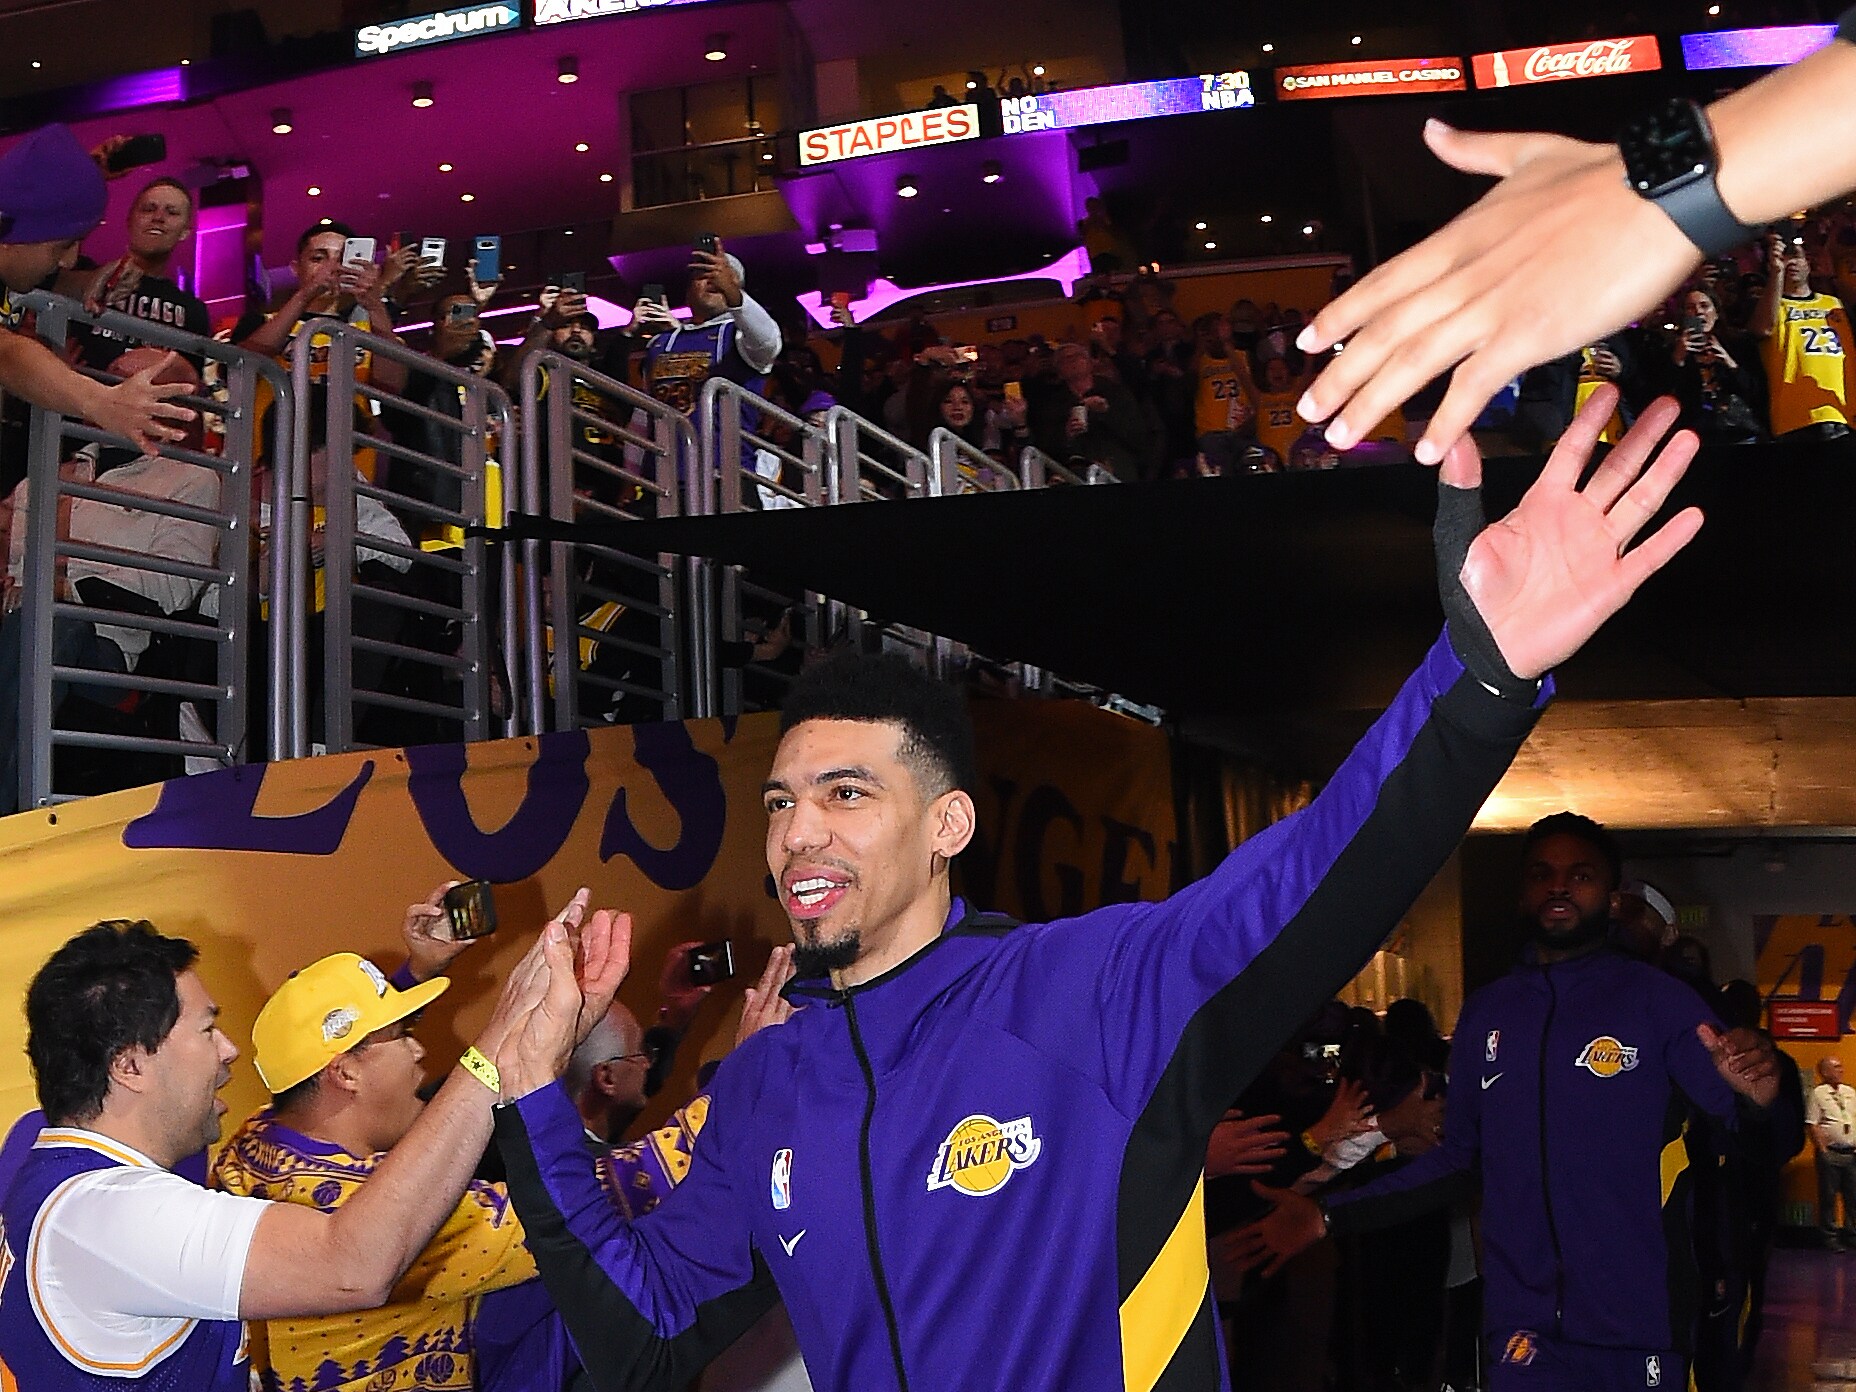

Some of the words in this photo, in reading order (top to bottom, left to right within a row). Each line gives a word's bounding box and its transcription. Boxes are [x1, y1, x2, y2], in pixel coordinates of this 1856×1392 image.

[357, 5, 510, 53] Spectrum
[1524, 40, 1635, 81] Coca-Cola
[1199, 69, 1250, 92] 7:30
[1296, 75, 1331, 89] SAN
[1331, 71, 1398, 86] MANUEL
[1398, 68, 1461, 82] CASINO
[1001, 96, 1039, 116] NO
[1200, 88, 1256, 110] NBA
[806, 109, 970, 161] STAPLES
[1003, 111, 1057, 135] DEN
[110, 294, 186, 327] ICAGO
[1799, 326, 1844, 356] 23
[1211, 379, 1240, 401] 23
[1269, 409, 1294, 428] 23
[938, 1132, 1029, 1183] LAKERS
